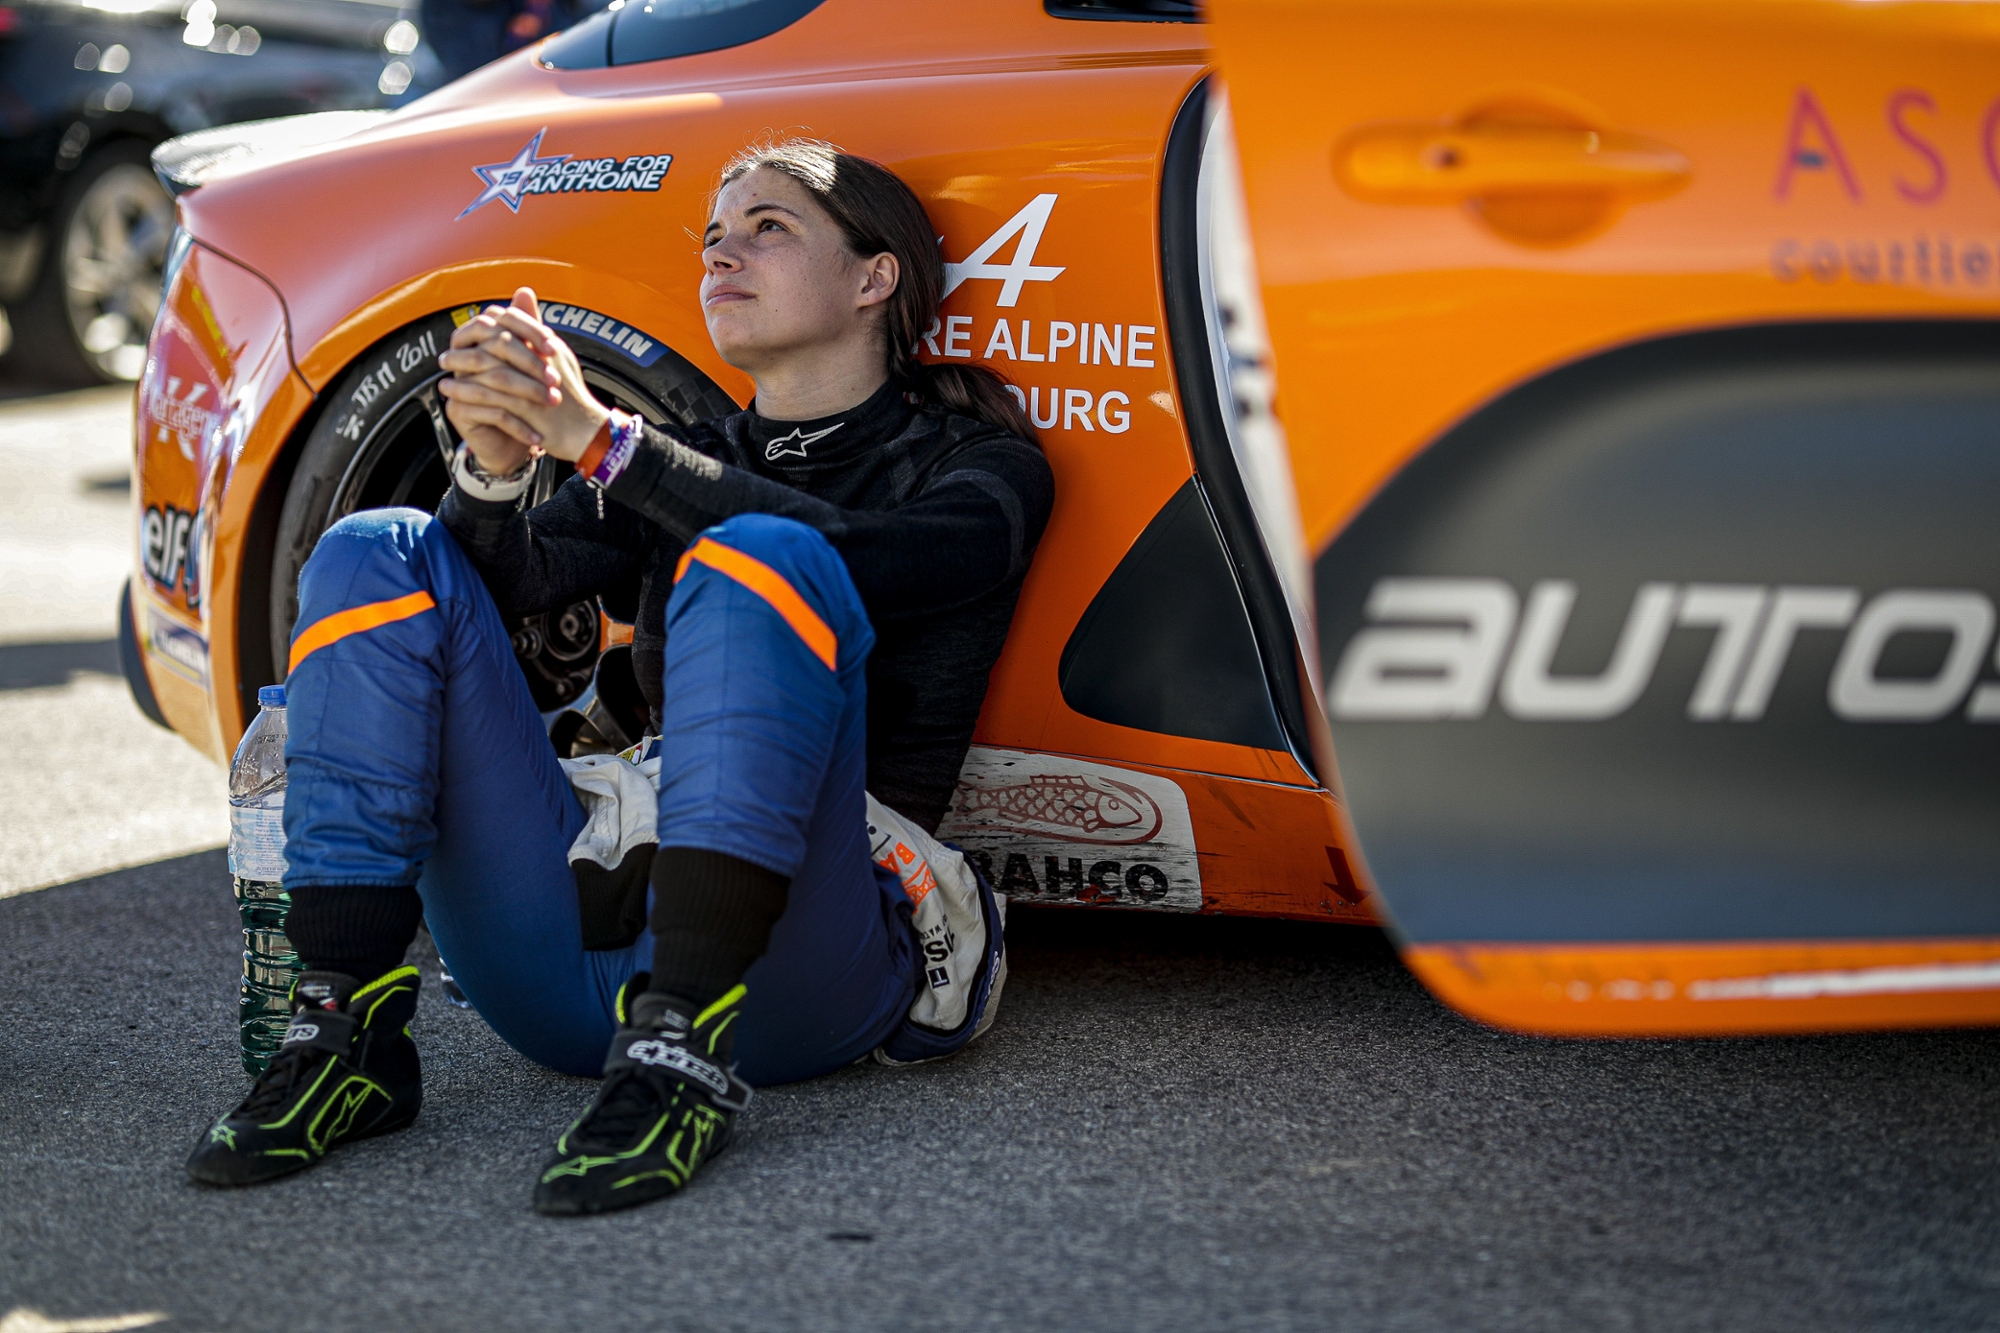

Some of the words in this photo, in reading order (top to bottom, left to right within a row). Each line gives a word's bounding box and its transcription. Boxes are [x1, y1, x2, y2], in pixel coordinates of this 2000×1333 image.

[1771, 85, 2000, 205] AS
[500, 170, 524, 186] 19
[520, 170, 667, 194] ANTHOINE
[529, 158, 617, 179] RACING
[620, 154, 673, 172] FOR
[983, 318, 1156, 368] ALPINE
[146, 506, 190, 586] elf
